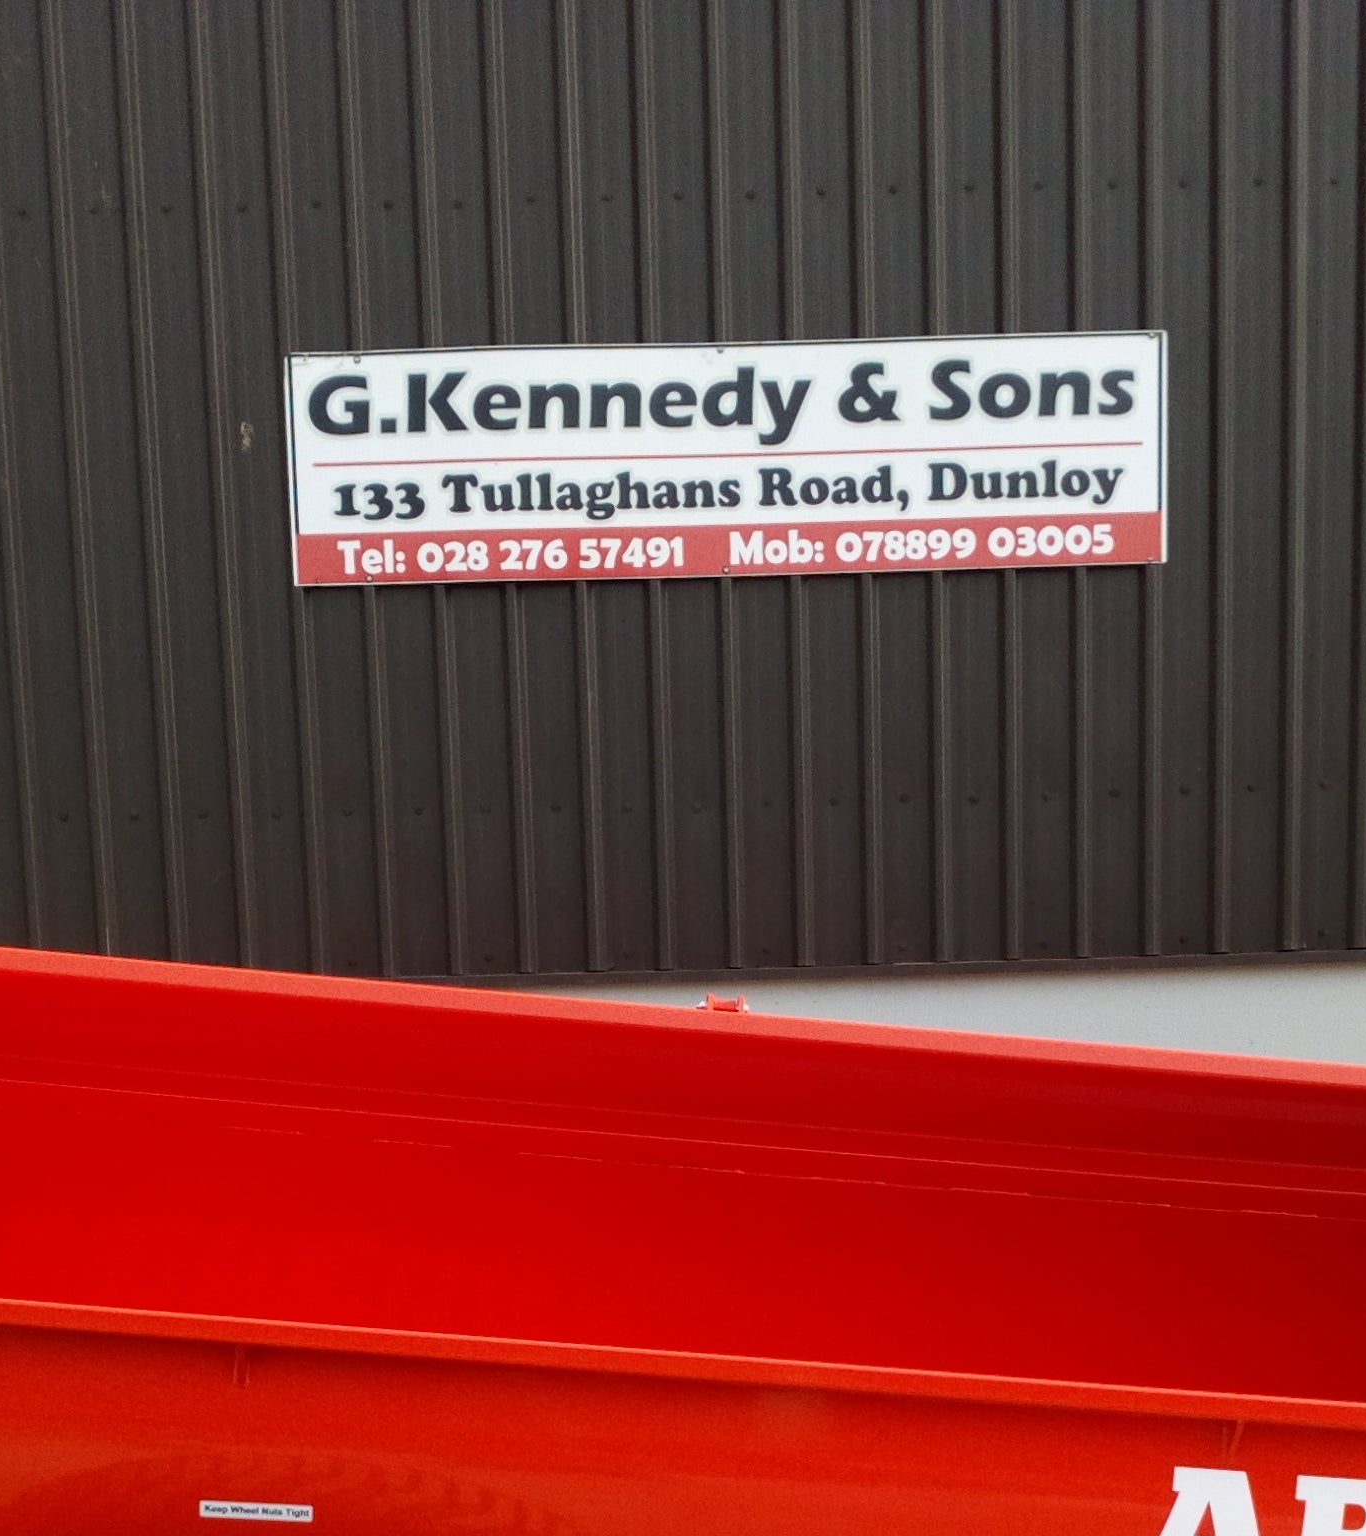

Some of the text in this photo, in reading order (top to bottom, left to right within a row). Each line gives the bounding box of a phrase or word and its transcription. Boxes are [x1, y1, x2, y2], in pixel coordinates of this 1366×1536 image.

[308, 360, 1134, 446] G.Kennedy & Sons
[334, 460, 1123, 521] 133 Tullaghans Road, Dunloy
[336, 523, 1115, 575] Tel: 028 276 57491 Mob: 078899 03005
[204, 1504, 310, 1518] Keep Wheel Nuts Tight
